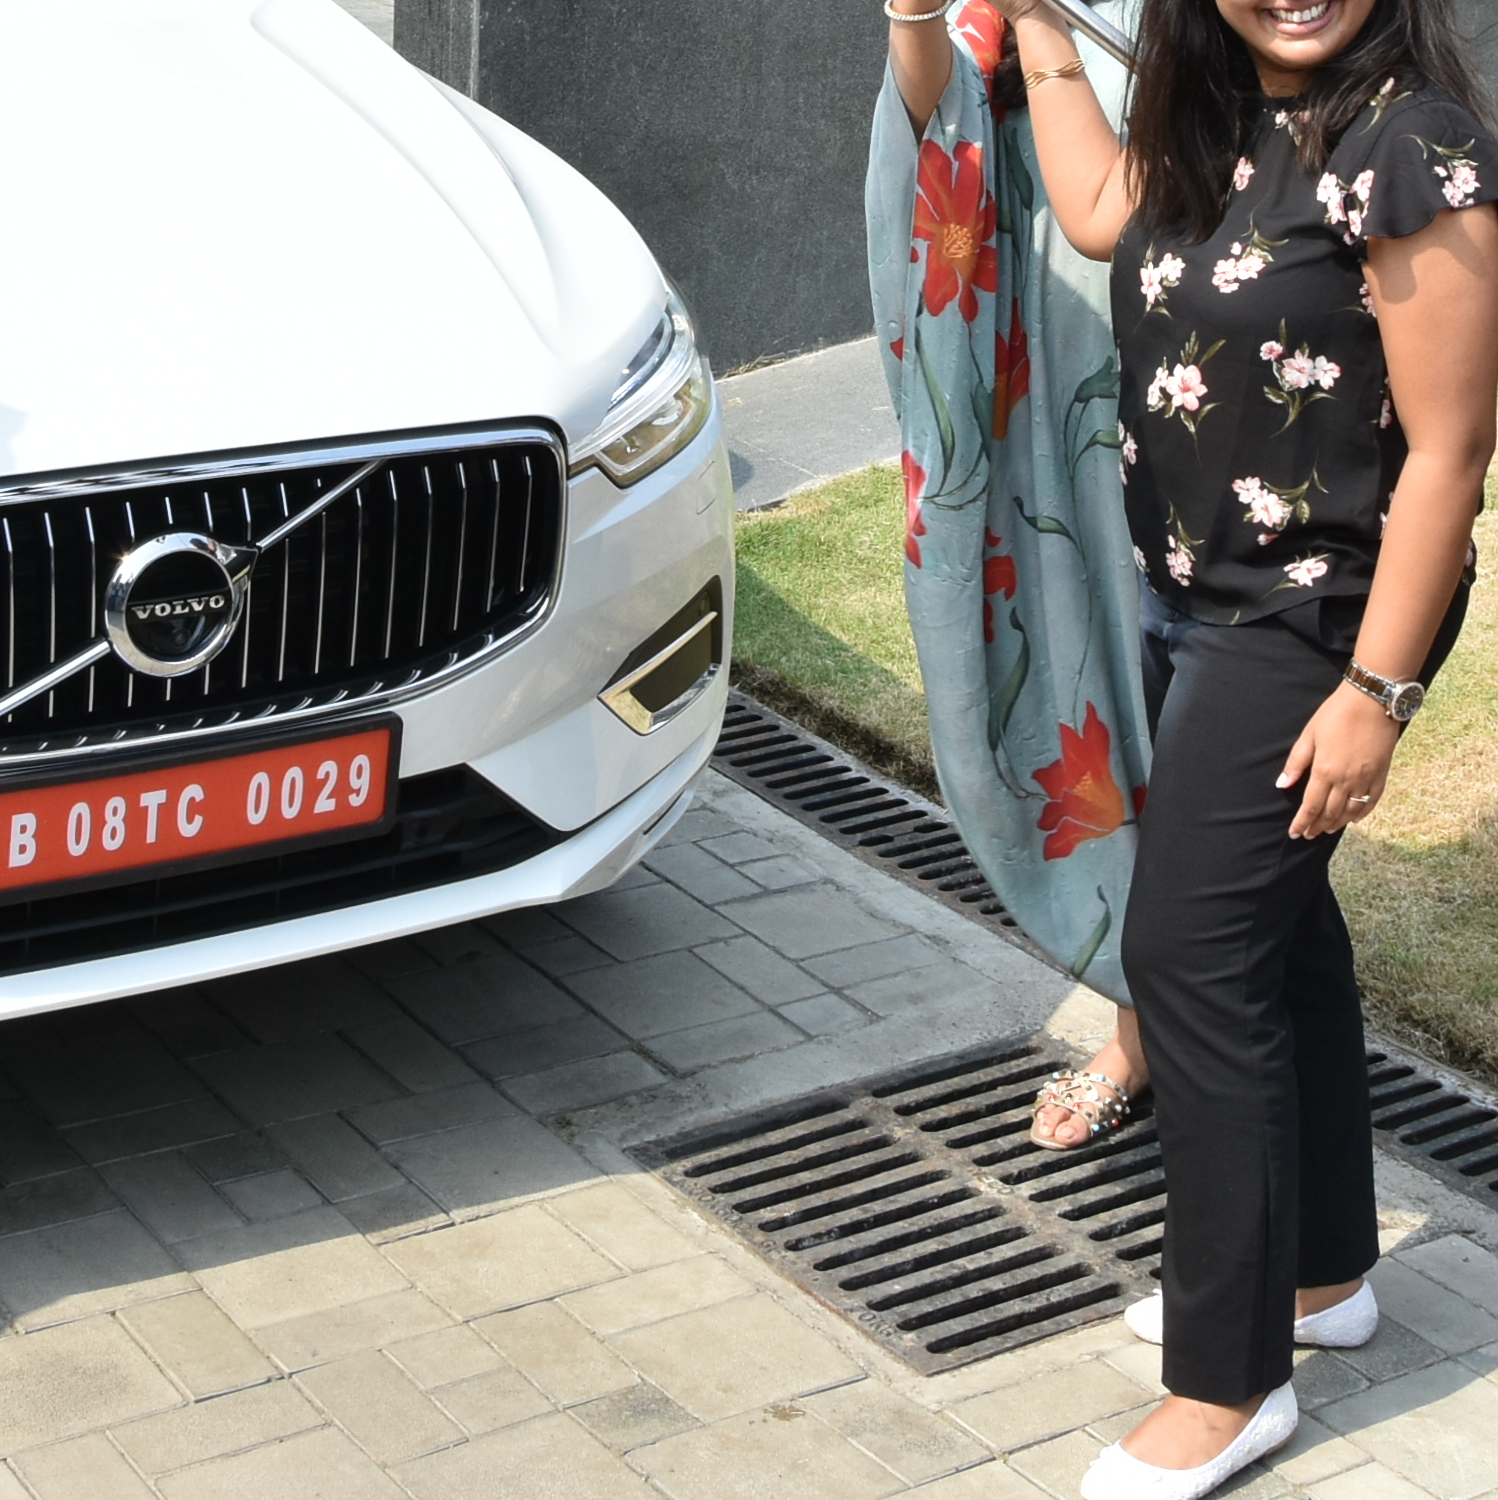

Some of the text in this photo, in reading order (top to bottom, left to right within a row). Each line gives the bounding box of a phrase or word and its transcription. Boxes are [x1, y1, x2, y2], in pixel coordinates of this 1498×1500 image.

[131, 594, 225, 620] VOLVO
[66, 784, 205, 857] 08TC
[246, 753, 371, 826] 0029
